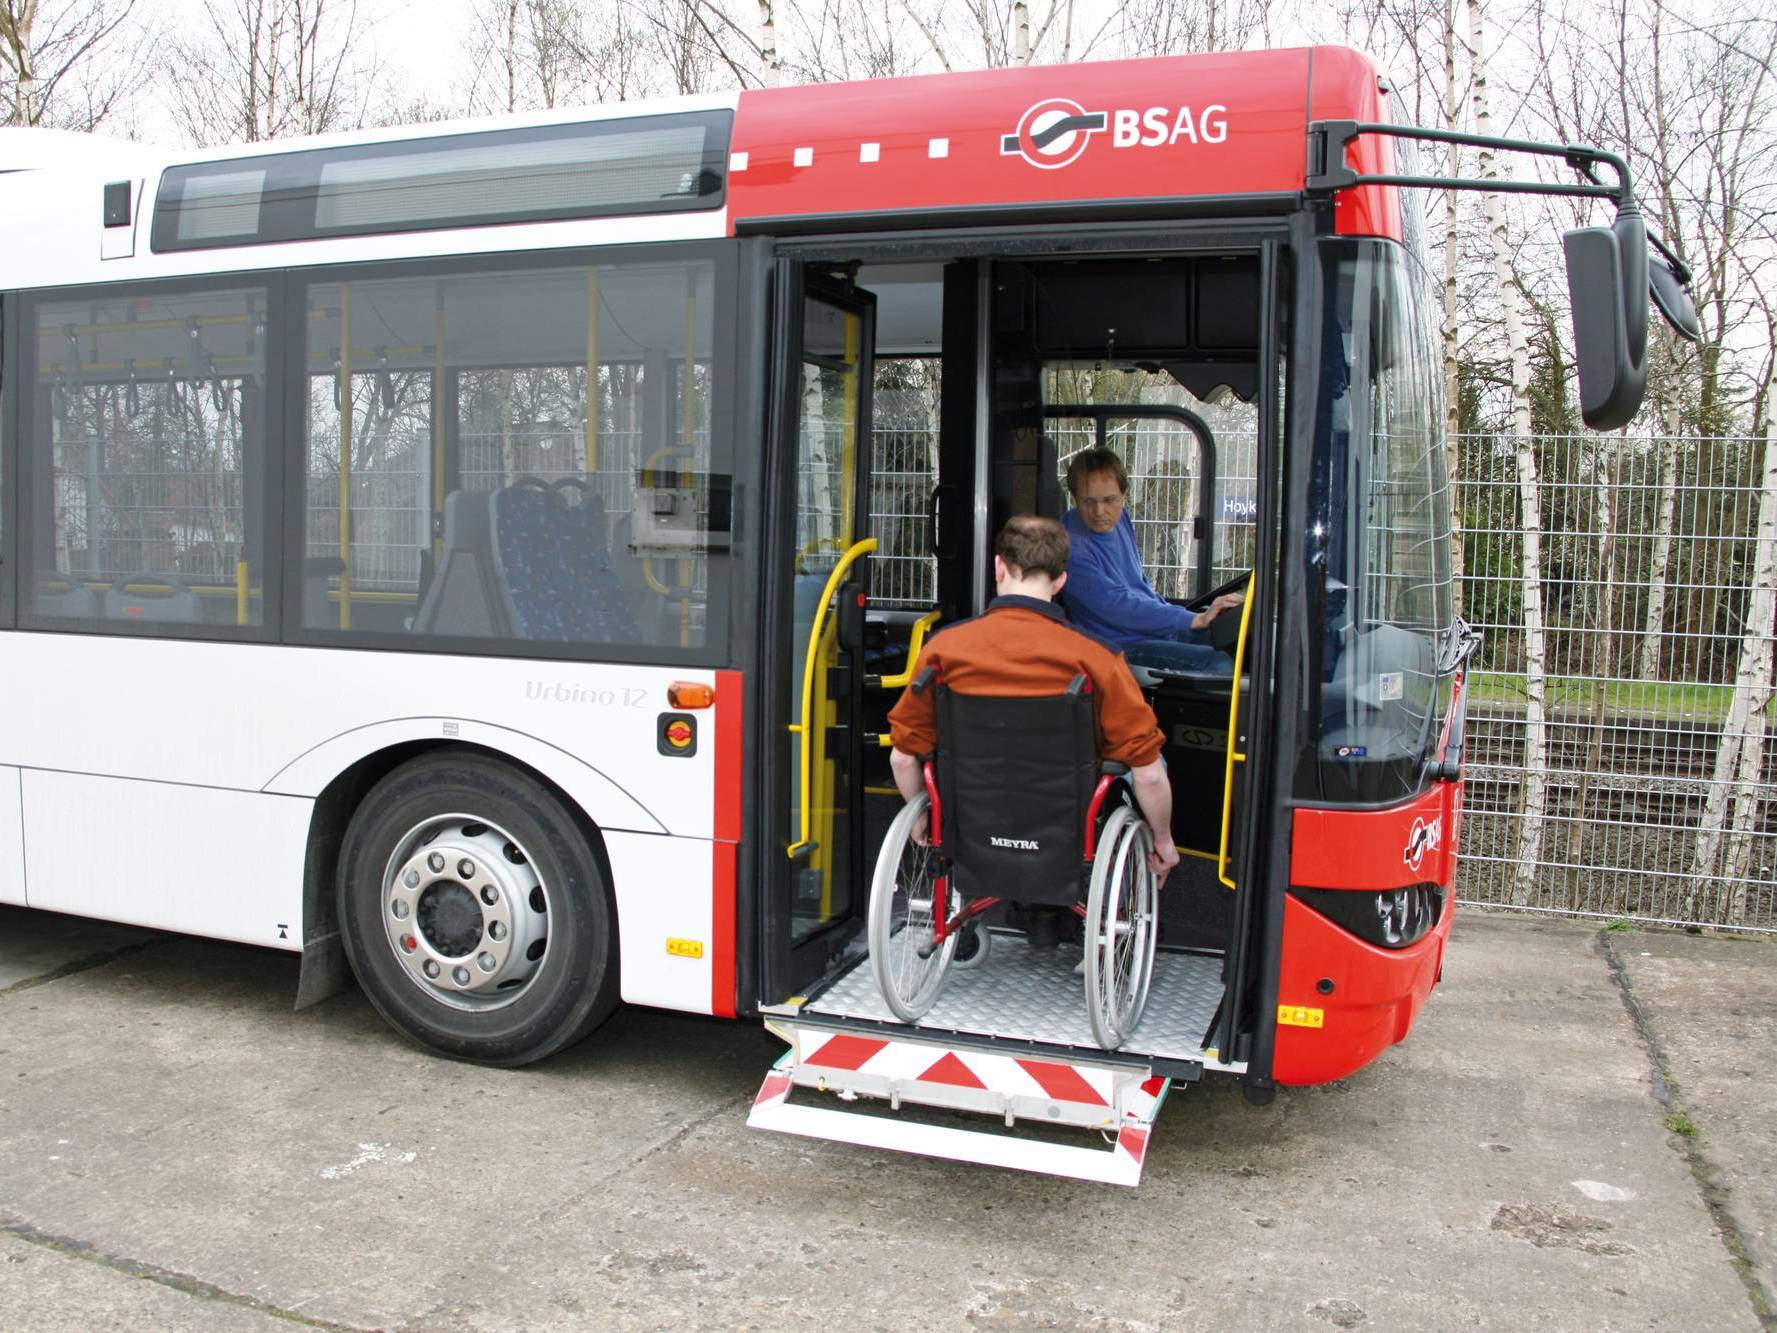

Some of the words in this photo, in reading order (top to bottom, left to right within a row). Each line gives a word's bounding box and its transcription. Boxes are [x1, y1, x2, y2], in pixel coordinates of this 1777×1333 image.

[1113, 104, 1228, 148] BSAG
[525, 681, 616, 706] Urbino
[623, 687, 648, 707] 12
[990, 836, 1040, 850] MEYRA
